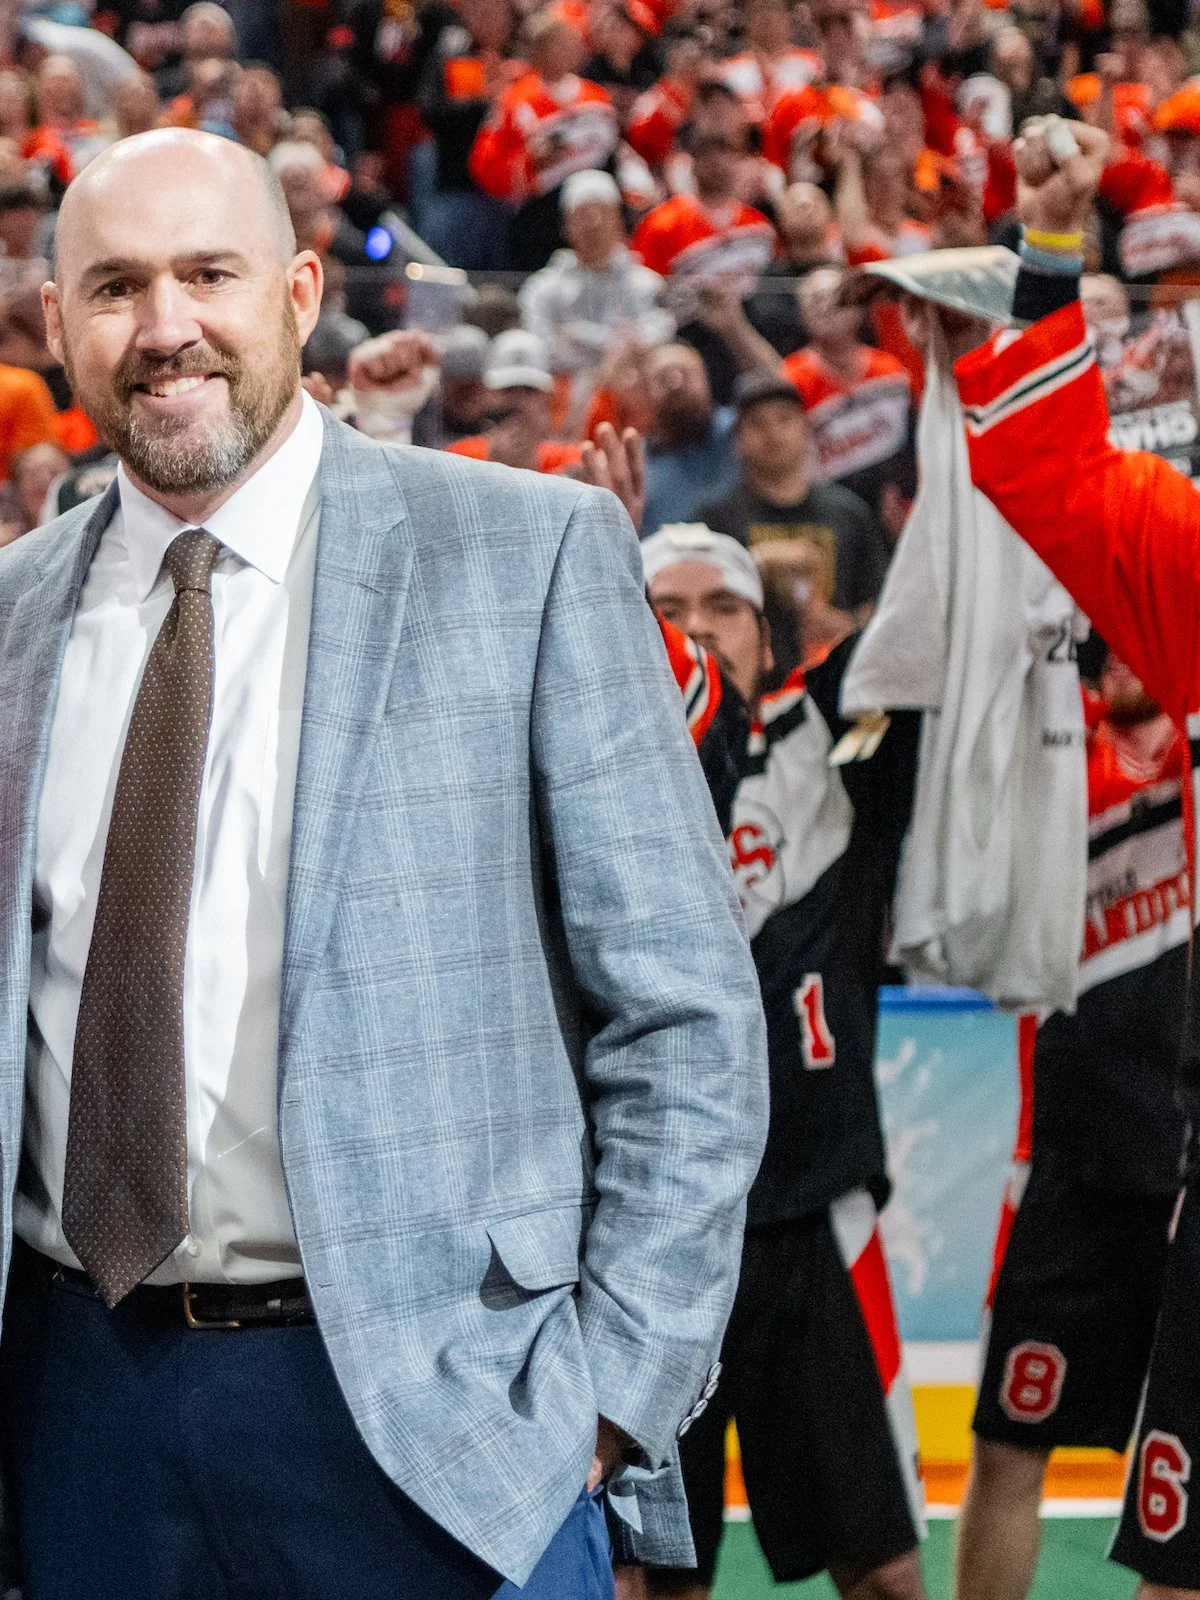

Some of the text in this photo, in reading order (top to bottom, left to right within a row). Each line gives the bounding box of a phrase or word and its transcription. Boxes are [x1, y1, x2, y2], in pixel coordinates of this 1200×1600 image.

[793, 971, 836, 1070] 1
[1001, 1340, 1067, 1424] 8
[1138, 1429, 1192, 1542] 6
